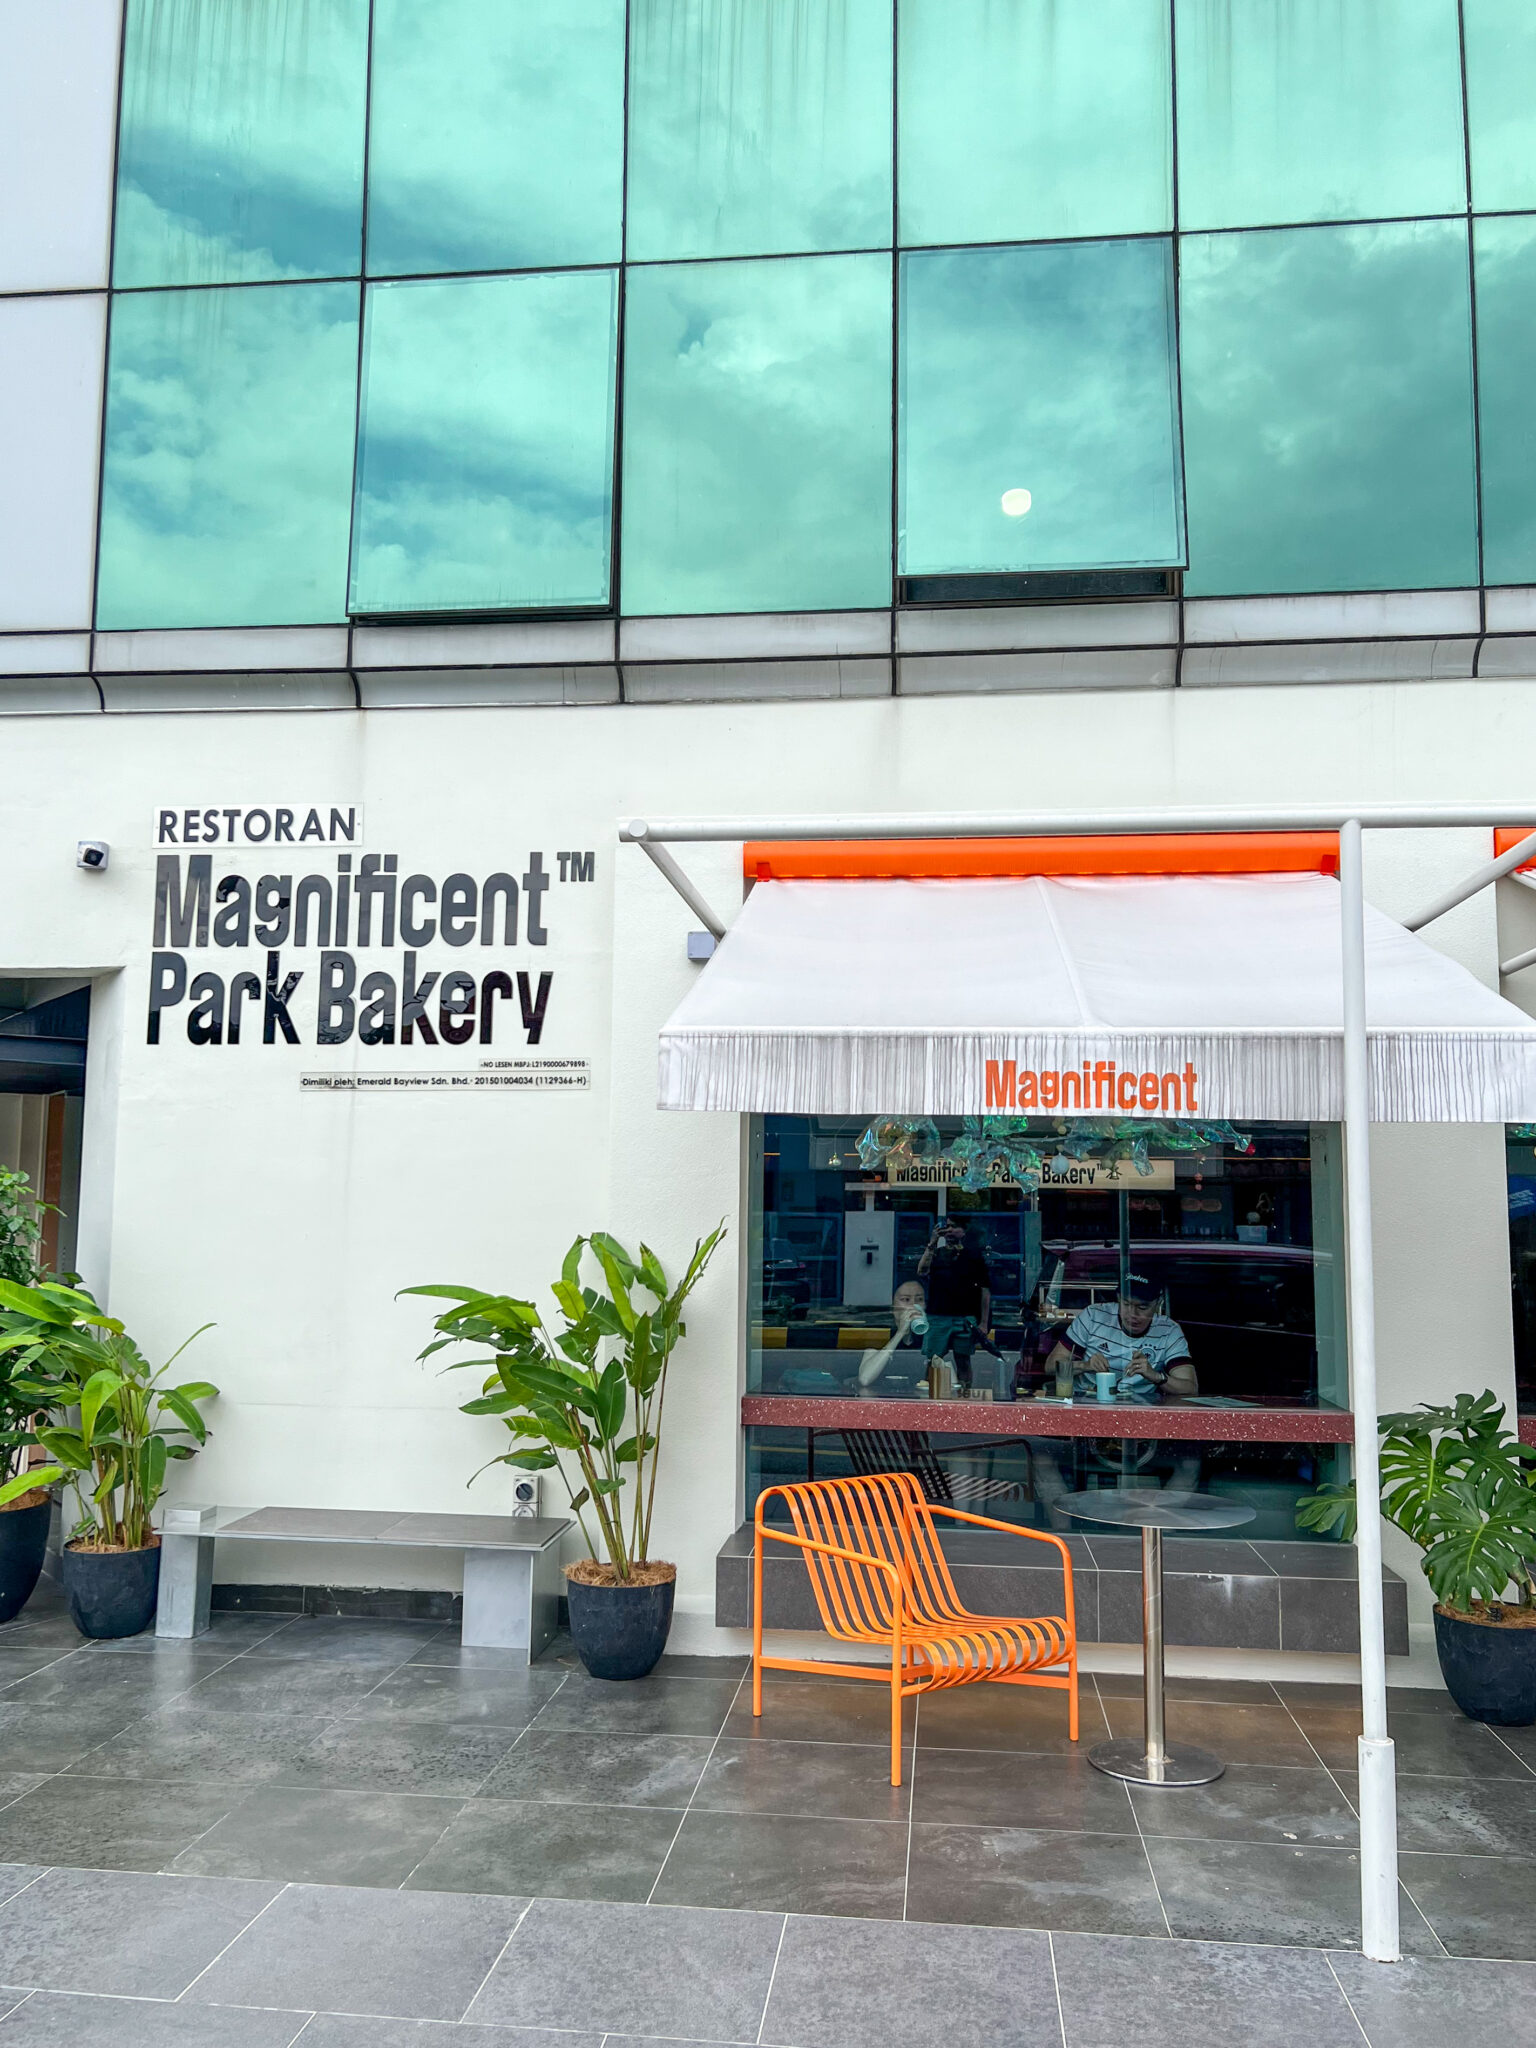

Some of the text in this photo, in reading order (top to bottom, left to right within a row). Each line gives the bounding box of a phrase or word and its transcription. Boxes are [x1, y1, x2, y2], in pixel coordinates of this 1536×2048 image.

[158, 807, 356, 843] RESTORAN
[152, 851, 550, 948] Magnificent
[146, 950, 554, 1045] Park Bakery
[357, 1077, 392, 1086] Emerald
[394, 1077, 429, 1087] Bayview
[431, 1076, 449, 1085] Sdn.
[475, 1075, 533, 1085] 201501004034
[536, 1075, 587, 1086] (1129366-H)
[483, 1060, 494, 1069] NO
[495, 1060, 513, 1069] LESEN
[985, 1059, 1197, 1112] Magnificent
